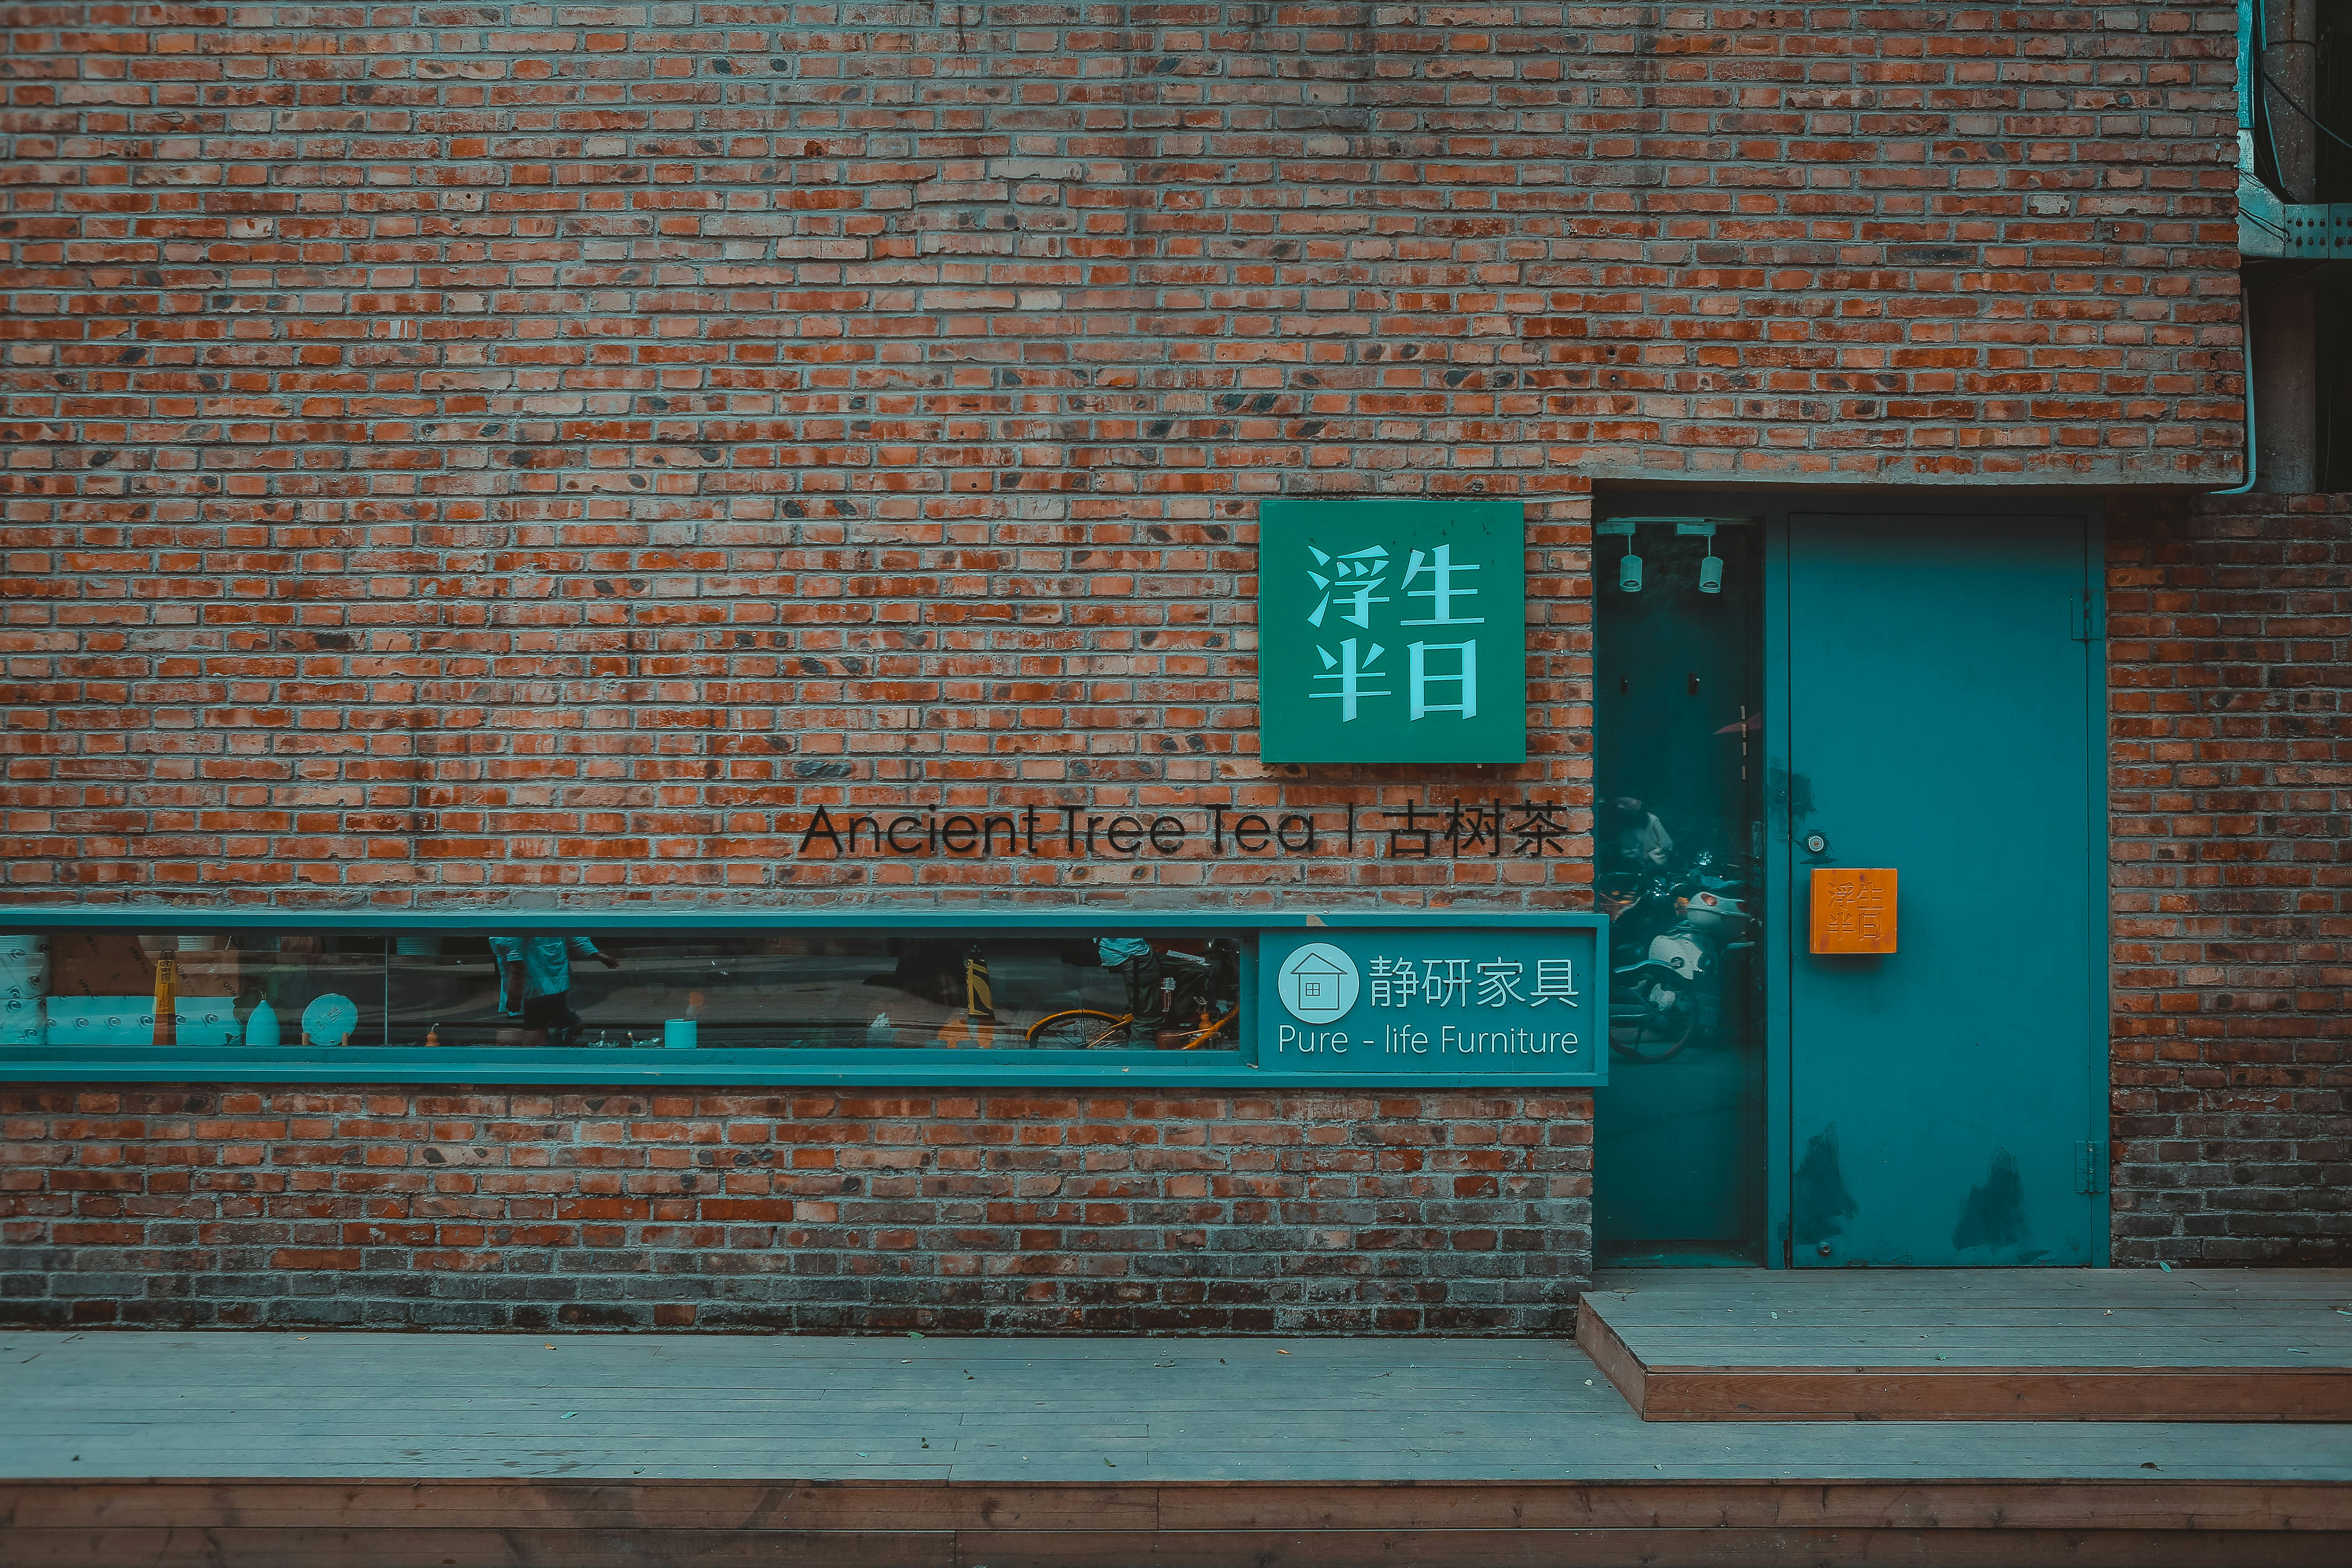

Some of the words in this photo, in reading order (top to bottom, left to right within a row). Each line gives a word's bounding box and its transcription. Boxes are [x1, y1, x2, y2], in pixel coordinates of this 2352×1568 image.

[1307, 544, 1485, 629] 浮生
[1309, 638, 1477, 723] 半日
[799, 803, 1038, 853] Ancient
[1058, 805, 1185, 853] Tree
[1205, 804, 1314, 852] Tea
[1382, 797, 1568, 858] 古树茶
[1827, 881, 1885, 911] 浮生
[1827, 911, 1882, 941] 半日
[128, 944, 142, 962] UPM
[1368, 954, 1580, 1008] 静研家具
[1278, 1024, 1349, 1054] Pure
[1385, 1023, 1429, 1054] life
[1441, 1024, 1579, 1054] Furniture
